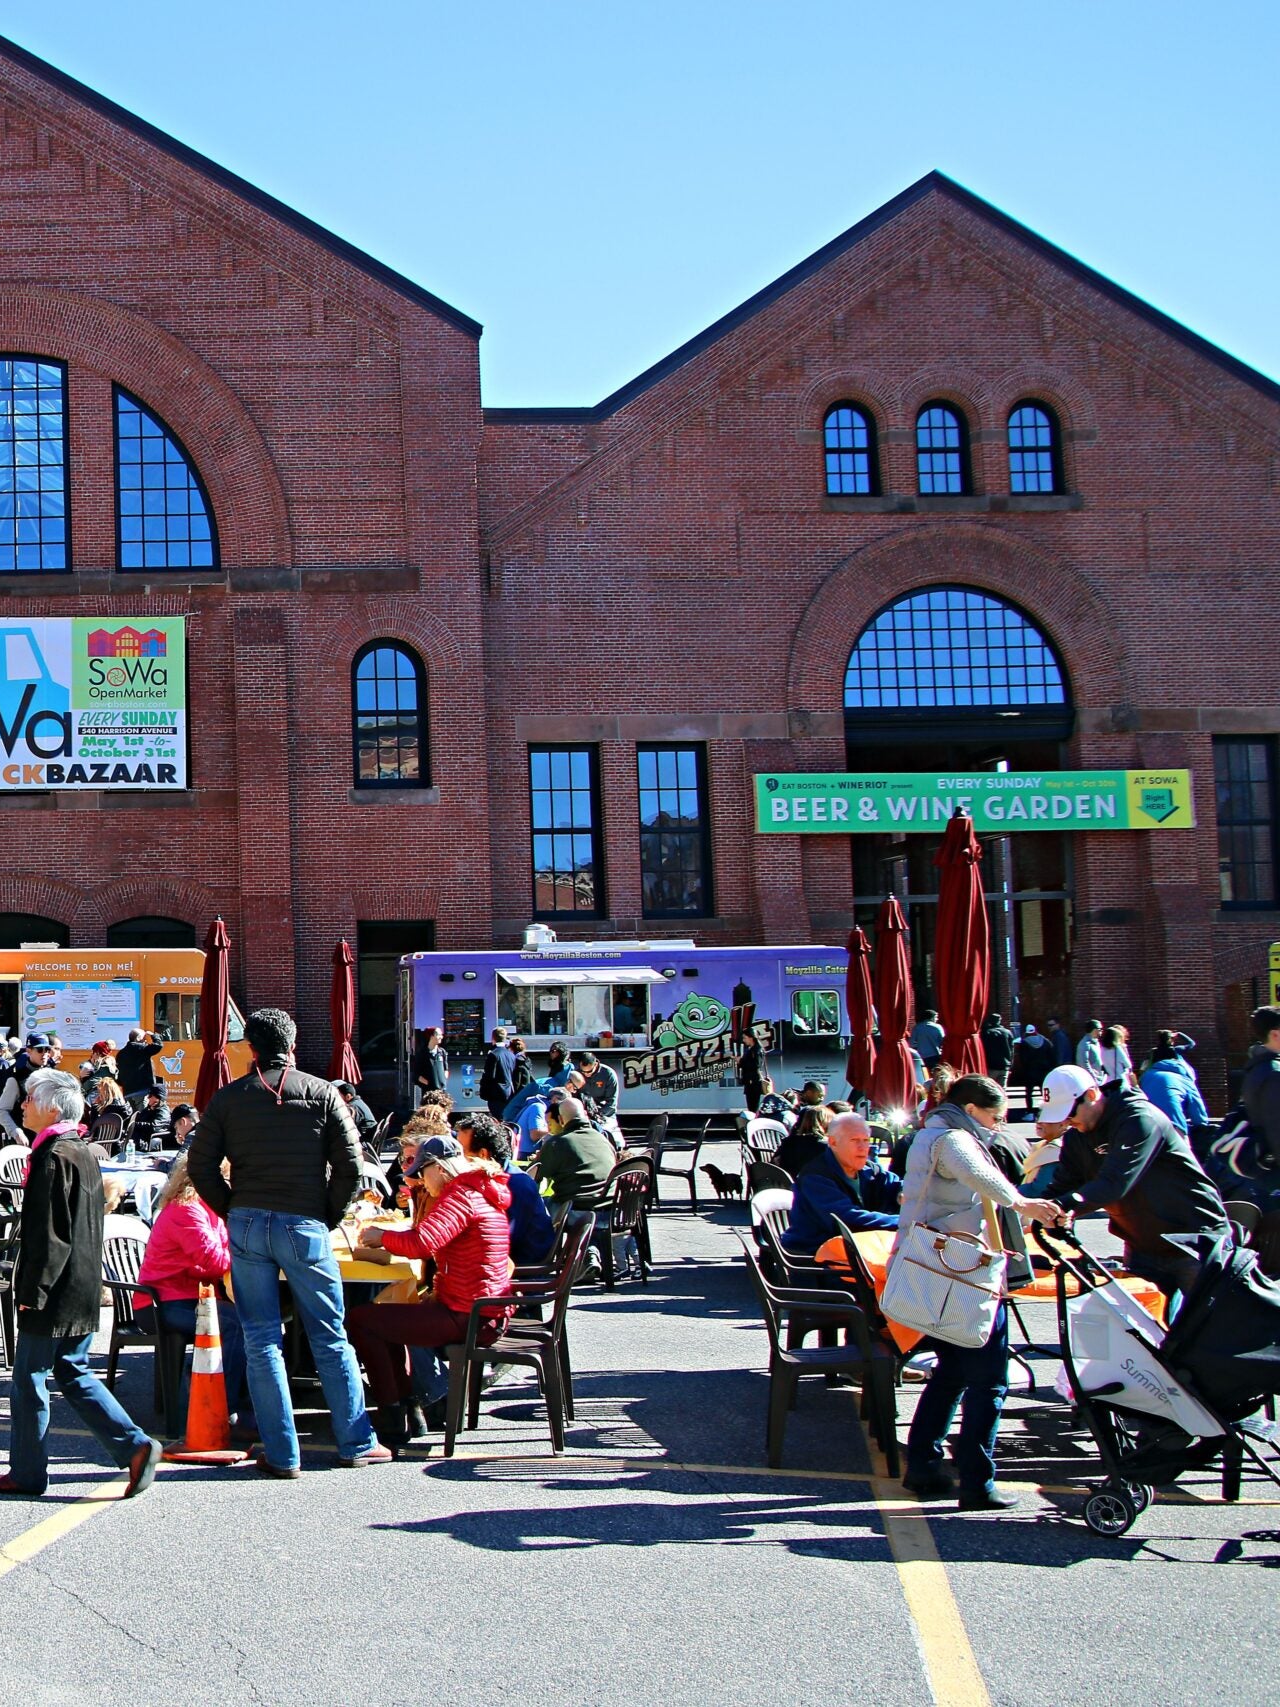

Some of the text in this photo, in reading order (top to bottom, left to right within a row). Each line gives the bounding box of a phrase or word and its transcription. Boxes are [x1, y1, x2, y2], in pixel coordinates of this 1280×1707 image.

[88, 658, 167, 687] SoWa
[88, 687, 167, 700] OpenMarket
[78, 711, 177, 726] EVERY SUNDAY
[81, 736, 117, 748] May
[123, 736, 144, 745] 1st
[78, 747, 177, 758] October 31st
[838, 781, 863, 789] WINE
[865, 781, 888, 789] RIOT
[937, 778, 982, 789] EVERY
[986, 777, 1042, 789] SUNDAY
[1133, 776, 1179, 785] AT SOWA
[1145, 794, 1165, 803] Right
[771, 794, 1117, 822] BEER & WINE GARDEN
[1145, 802, 1167, 810] HERE
[25, 960, 133, 971] WELCOME TO BON ME!
[785, 964, 848, 976] Moyzilla Cater
[678, 1066, 710, 1081] Comfort
[713, 1059, 733, 1072] Food
[1120, 1358, 1173, 1406] Summer
